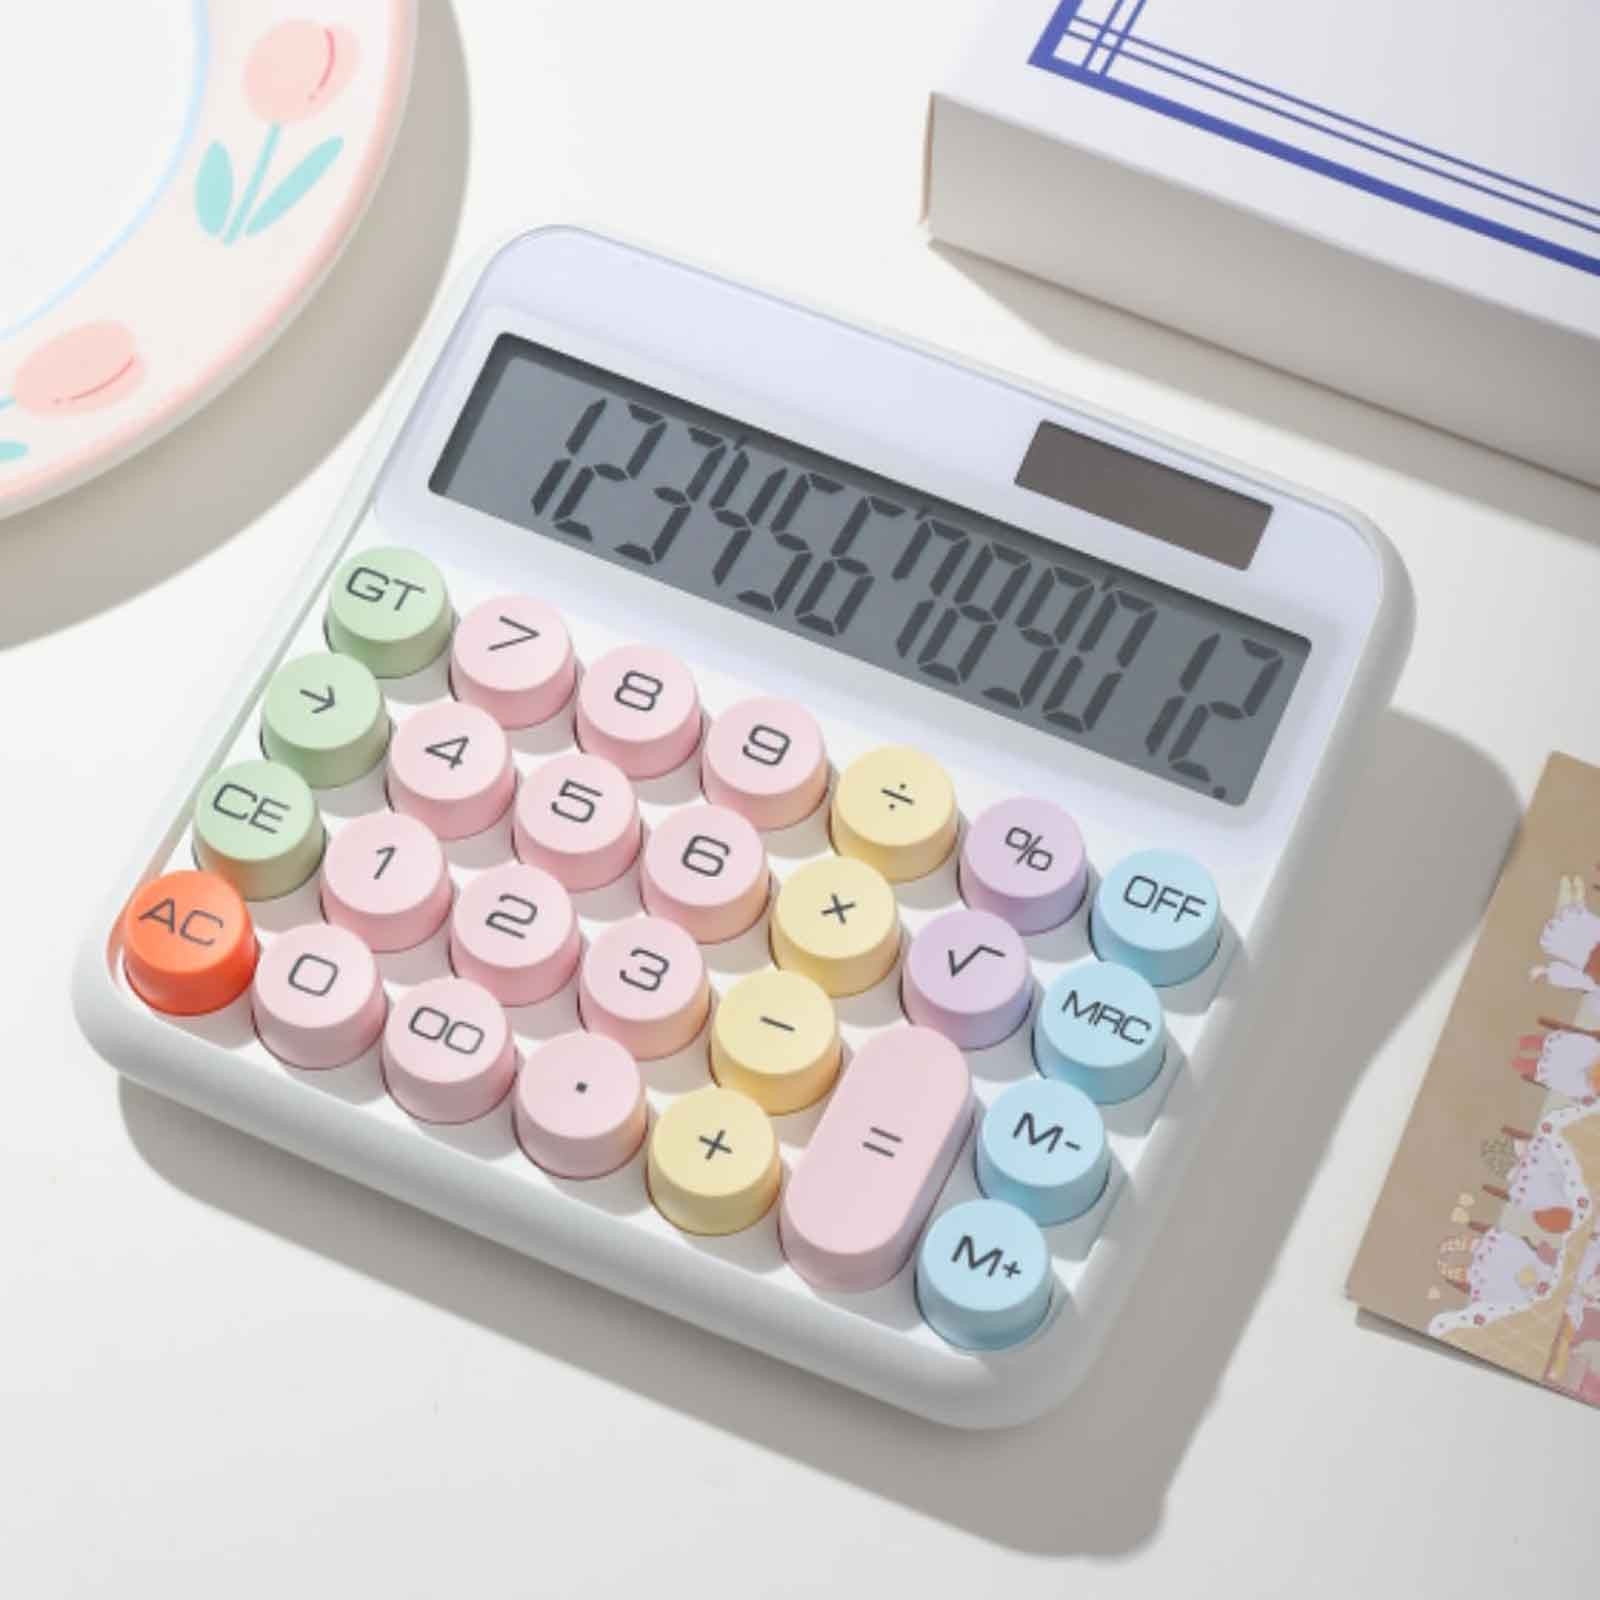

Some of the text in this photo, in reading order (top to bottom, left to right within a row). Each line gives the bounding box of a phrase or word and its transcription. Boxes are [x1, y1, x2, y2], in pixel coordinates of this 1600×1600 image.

[345, 566, 425, 611] GT
[487, 615, 540, 652] 7
[613, 670, 664, 712] 8
[424, 736, 470, 770] 4
[741, 724, 792, 767] 9
[211, 782, 290, 834] CE
[550, 778, 603, 824] 5
[373, 845, 397, 880] 1
[681, 834, 731, 877] 6
[1004, 826, 1054, 872] %
[137, 897, 223, 946] AC
[484, 893, 538, 940] 2
[1122, 874, 1208, 924] OFF
[287, 953, 339, 997] 0
[619, 947, 670, 992] 3
[1059, 989, 1153, 1047] MRC
[1012, 1111, 1081, 1154] M-
[951, 1234, 1022, 1279] M+
